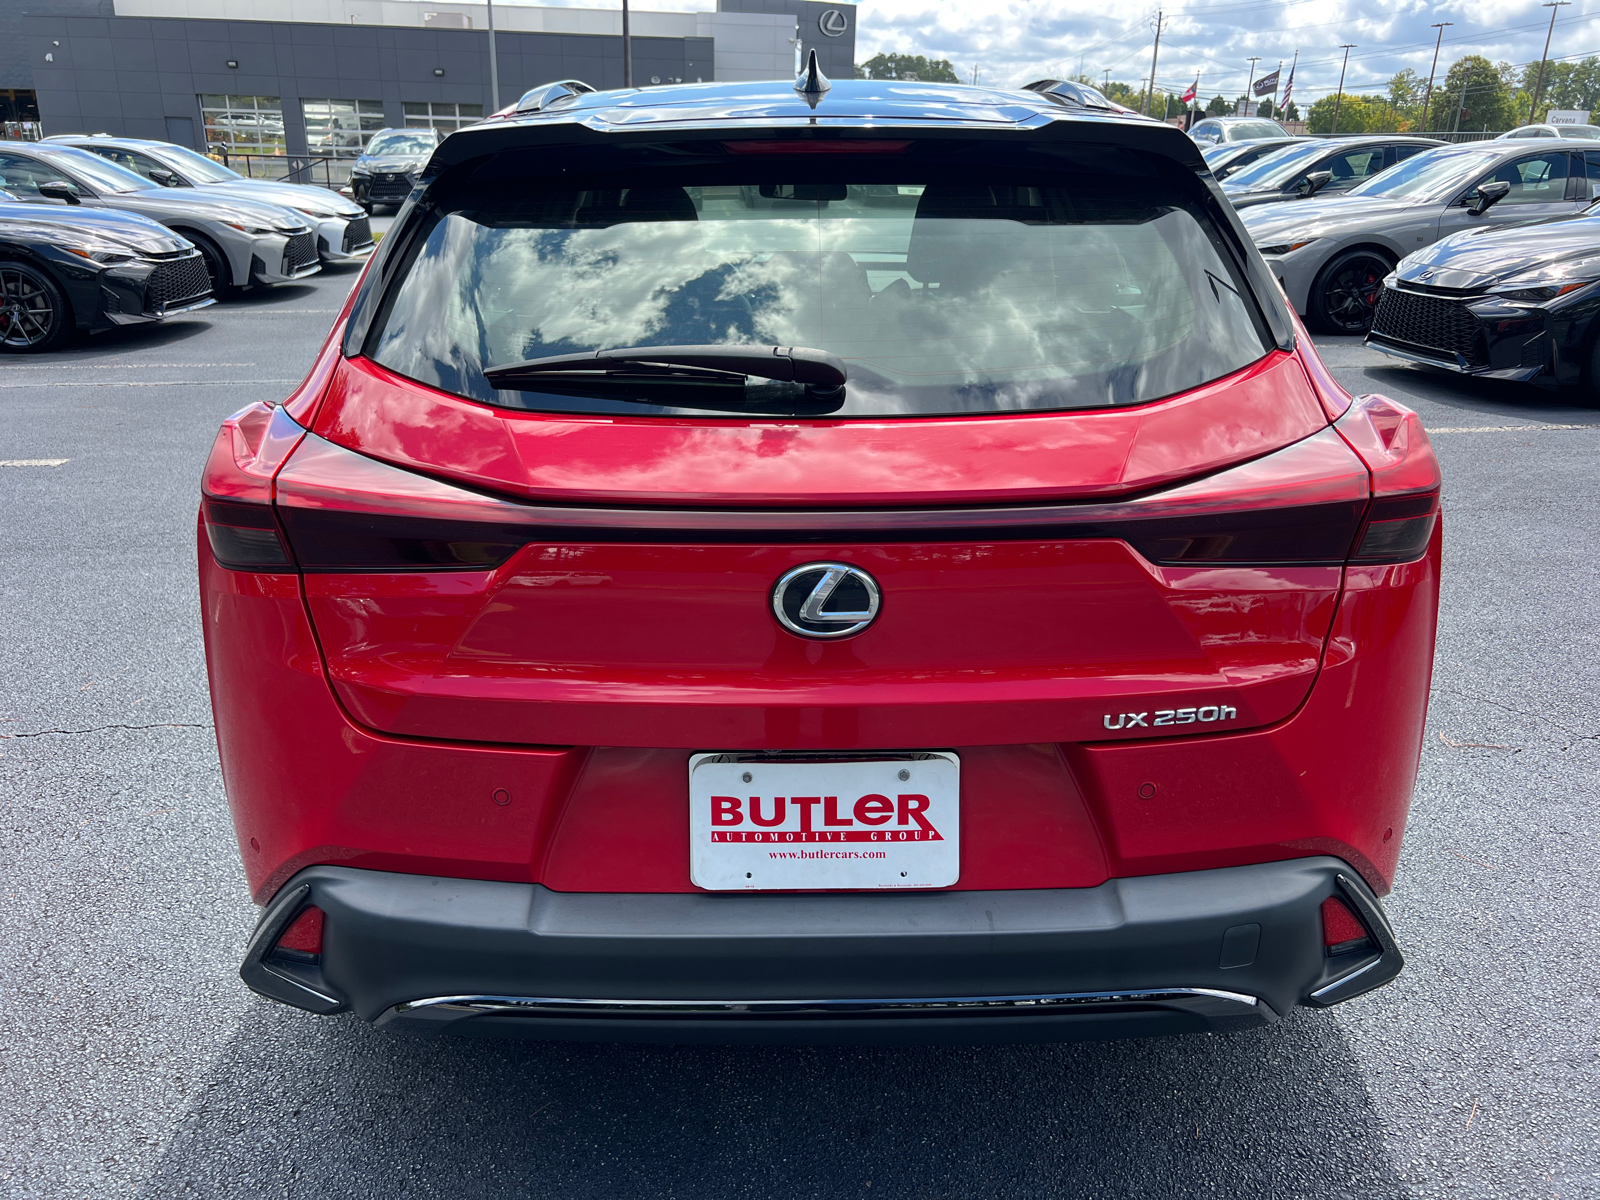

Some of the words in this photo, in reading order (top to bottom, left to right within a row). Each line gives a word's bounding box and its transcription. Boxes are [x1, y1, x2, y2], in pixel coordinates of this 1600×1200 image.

[1103, 711, 1149, 730] UX
[1152, 704, 1237, 727] 250h
[712, 831, 847, 842] AUTOMOTIVE
[870, 830, 936, 841] GROUP
[768, 849, 887, 860] www.butlercars.com
